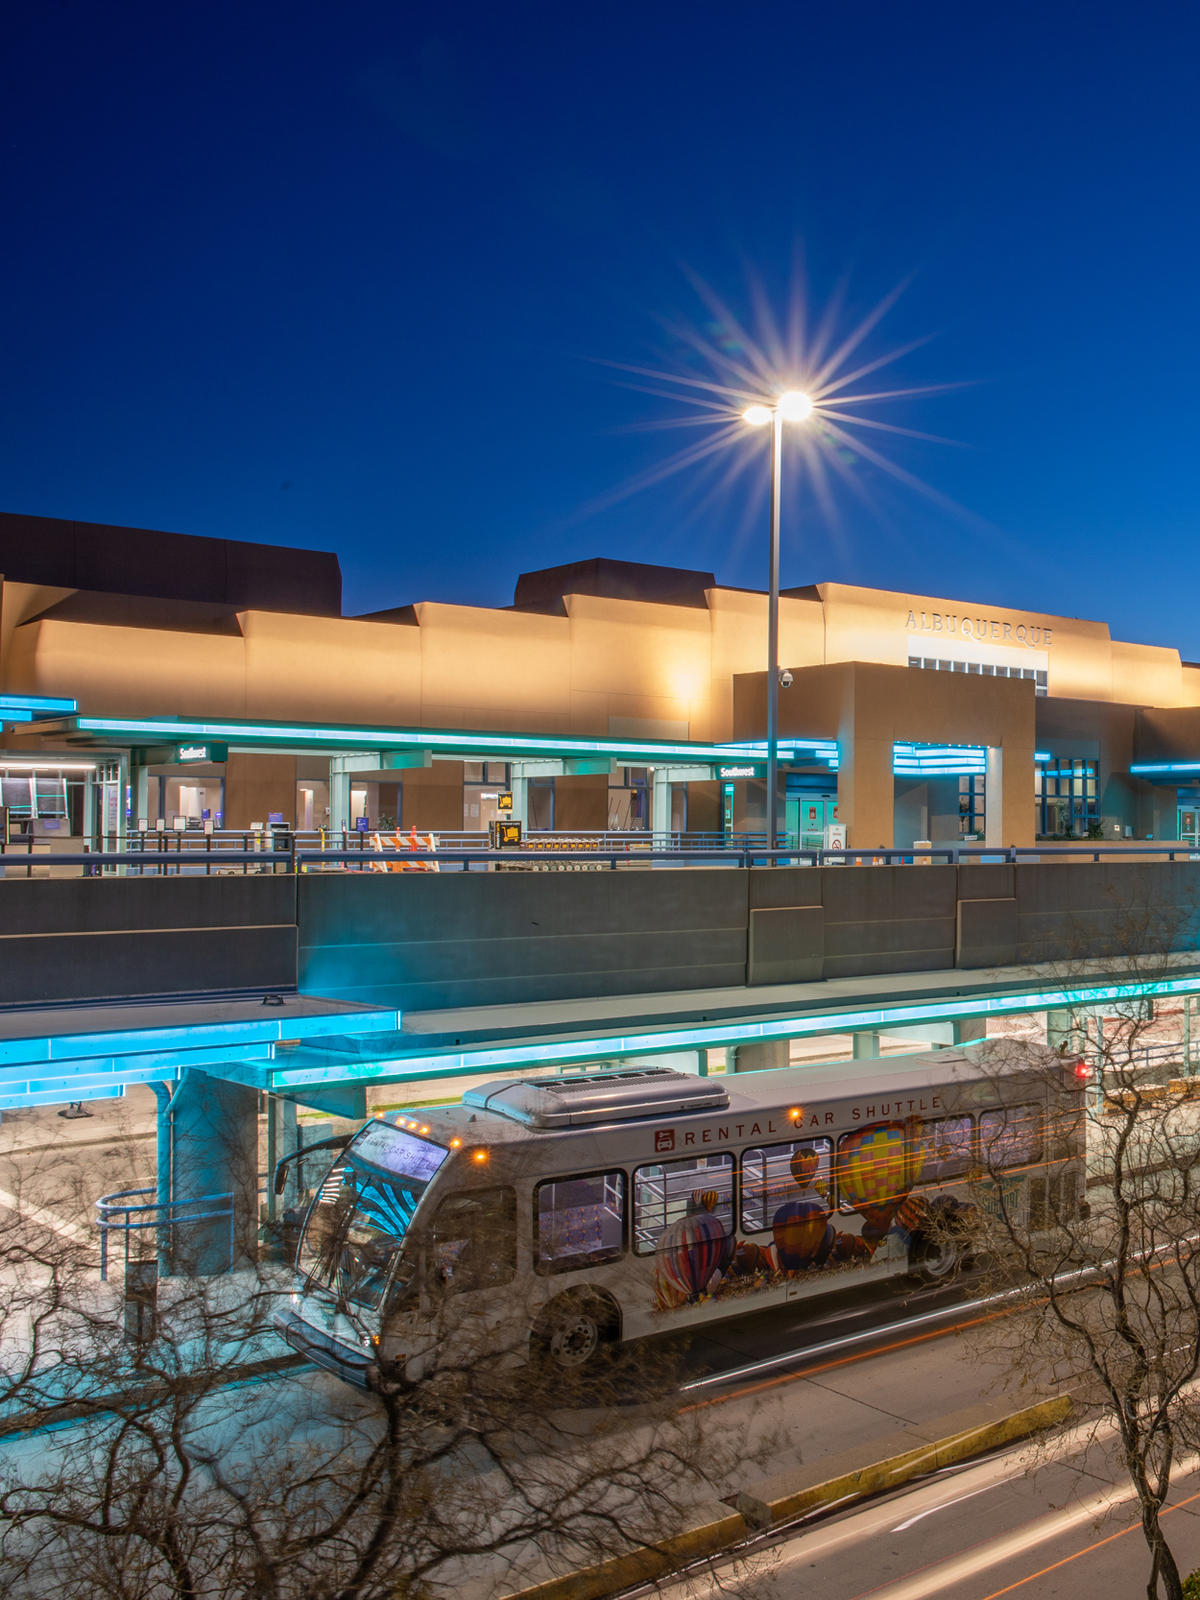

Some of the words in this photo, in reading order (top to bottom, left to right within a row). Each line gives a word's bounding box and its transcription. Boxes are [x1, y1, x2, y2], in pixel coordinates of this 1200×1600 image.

[905, 609, 1053, 648] ALBUQUERQUE
[720, 766, 755, 777] Southwest
[685, 1120, 777, 1145] RENTAL
[793, 1111, 835, 1129] CAR
[851, 1096, 941, 1120] SHUTTLE
